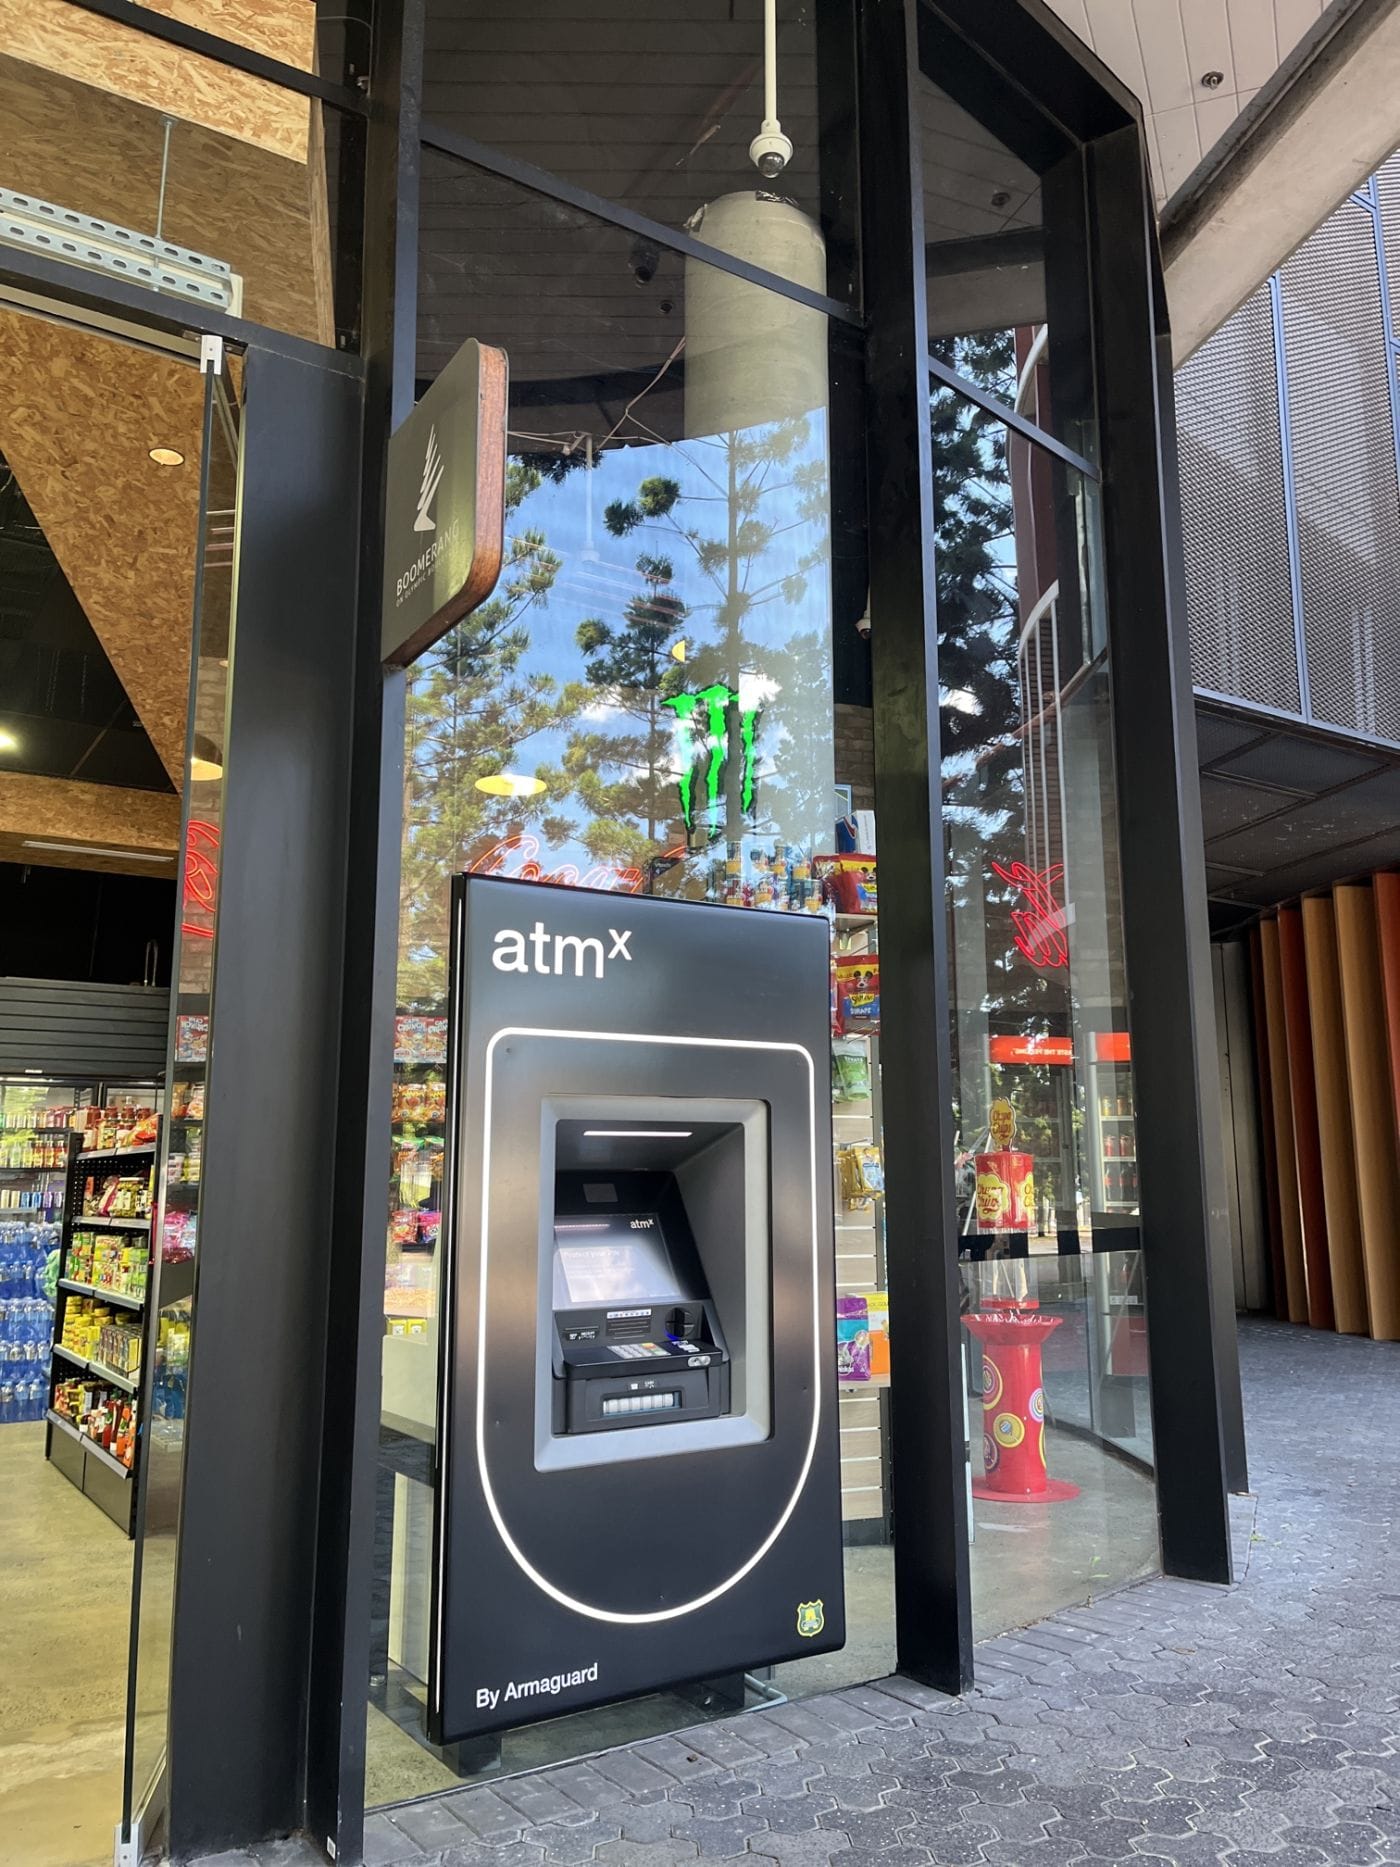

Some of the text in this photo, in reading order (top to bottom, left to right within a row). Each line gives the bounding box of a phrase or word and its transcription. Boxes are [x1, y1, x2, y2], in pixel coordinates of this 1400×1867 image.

[396, 518, 460, 597] BOOMERANG
[476, 1661, 599, 1710] By Armaguard
